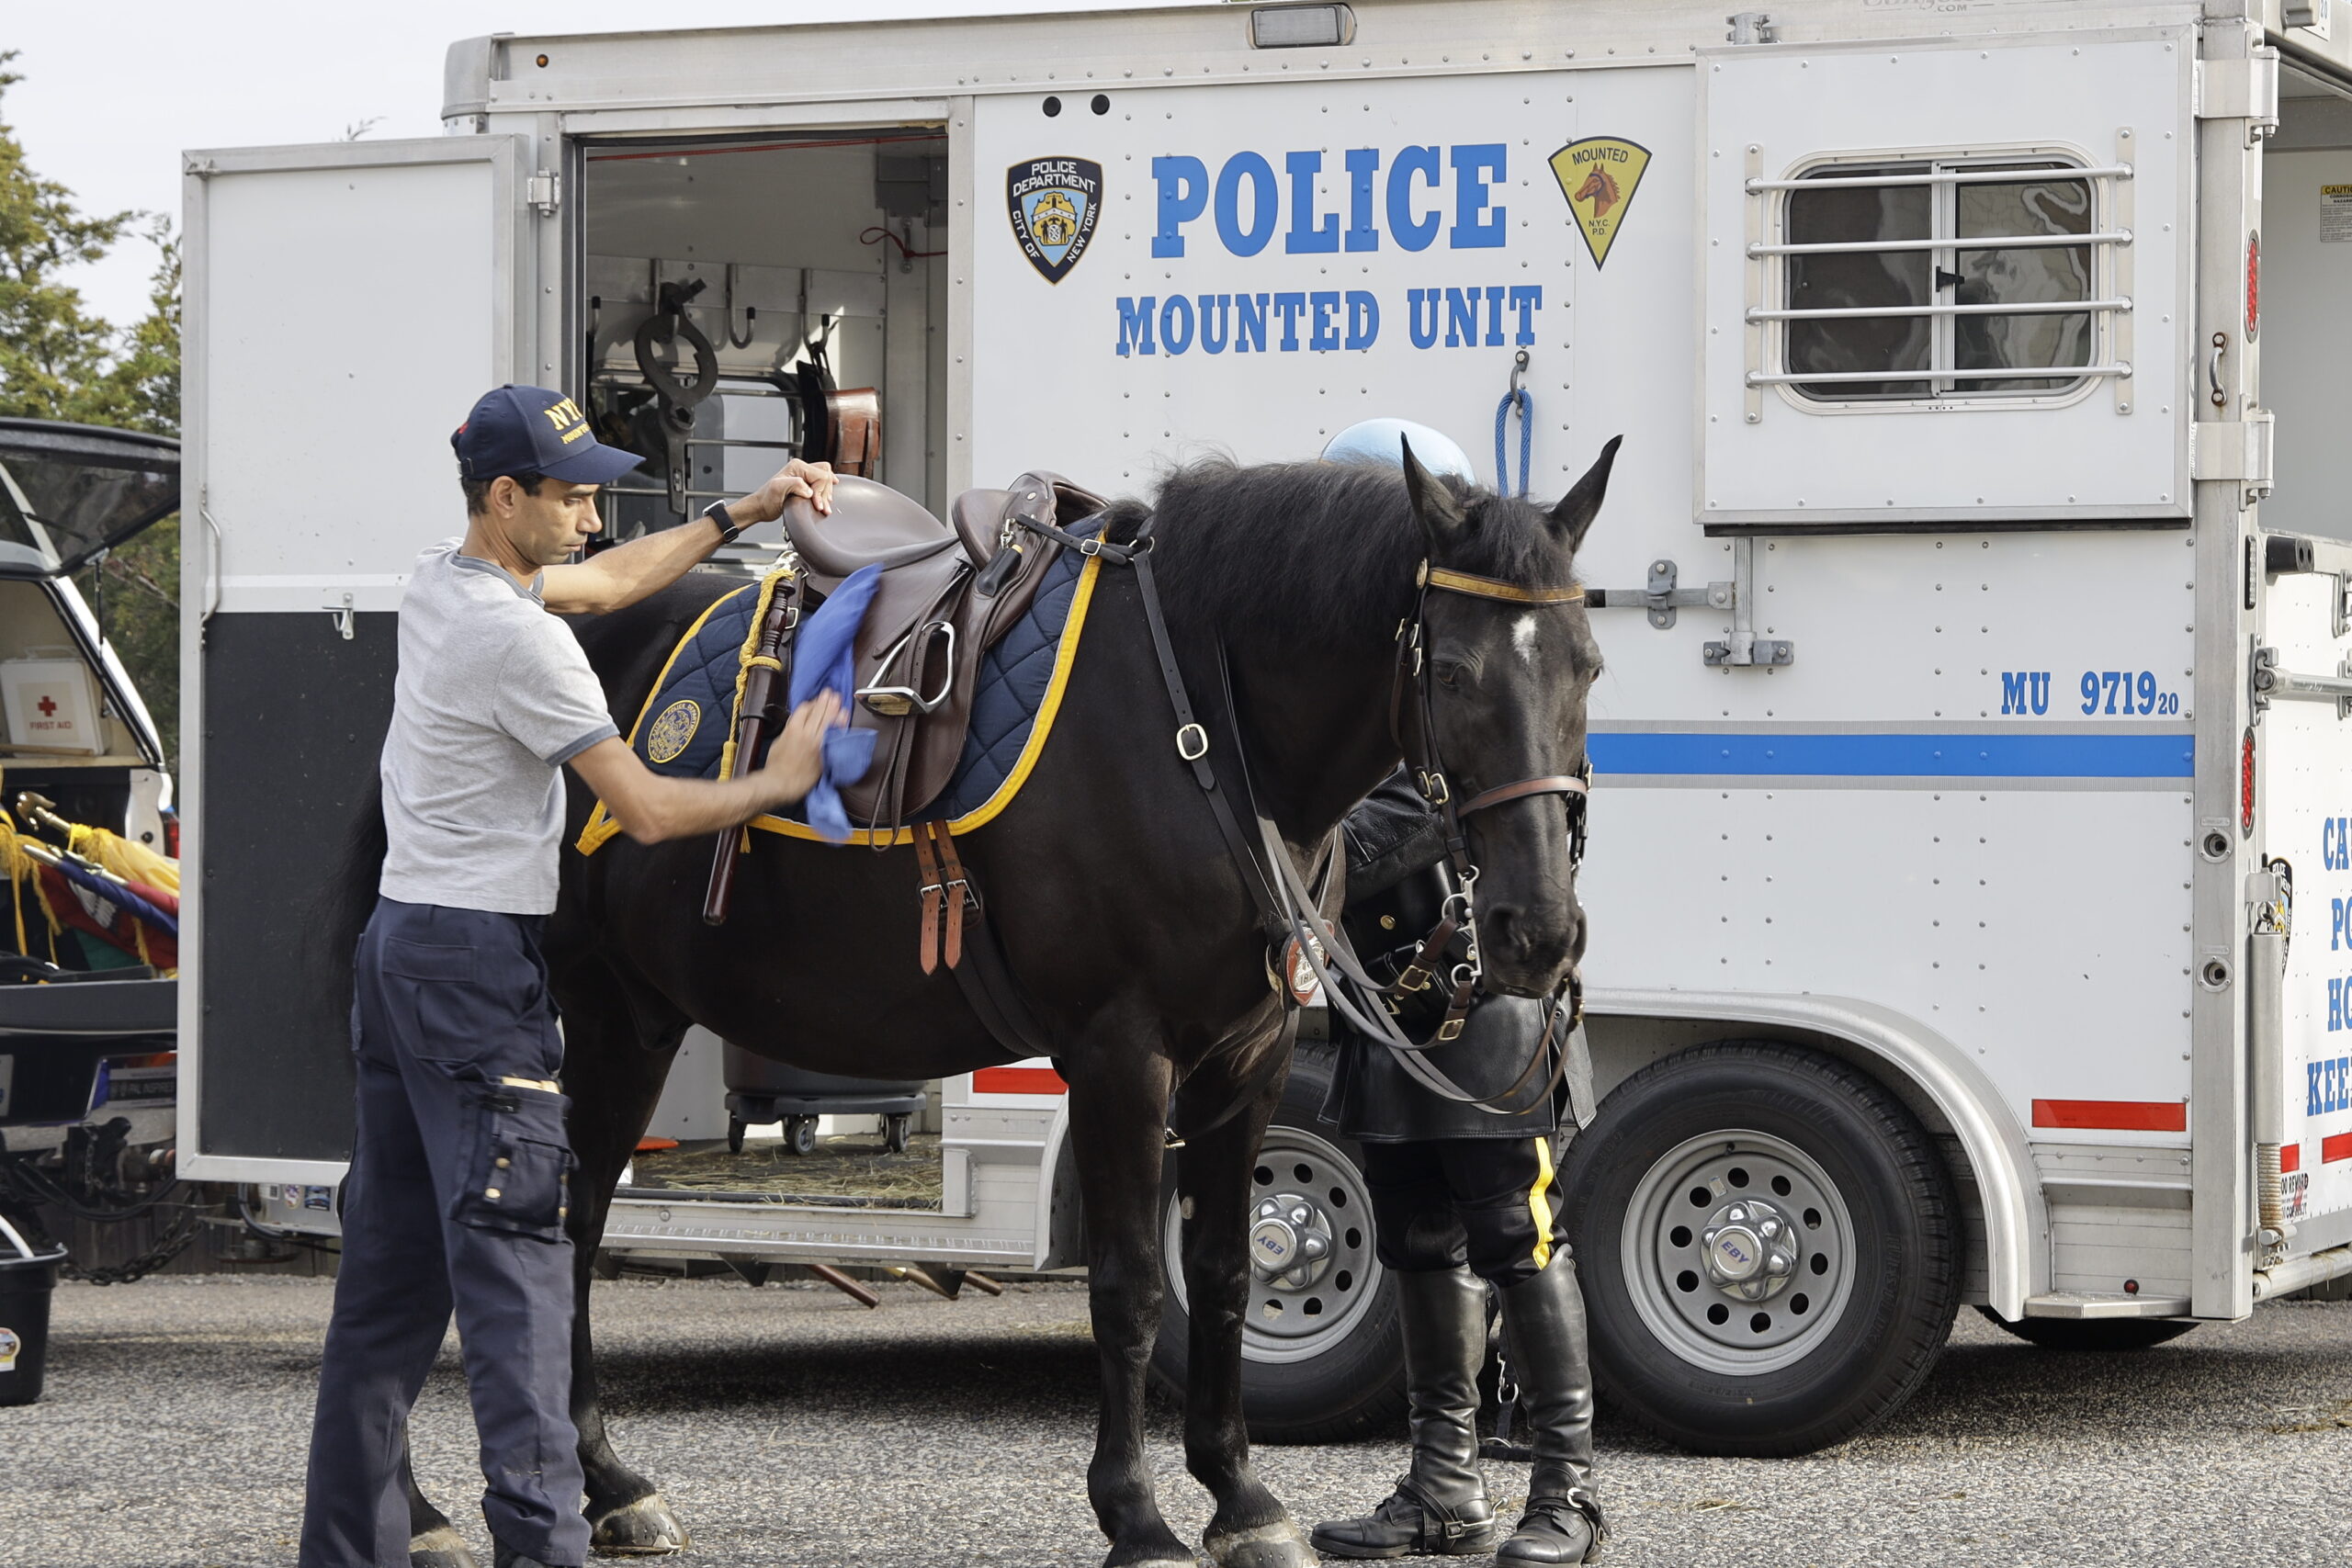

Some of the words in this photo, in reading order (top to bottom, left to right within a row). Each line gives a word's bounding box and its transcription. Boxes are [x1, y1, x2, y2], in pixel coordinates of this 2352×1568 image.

[1031, 161, 1077, 175] POLICE
[1572, 147, 1629, 165] MOUNTED
[1012, 174, 1096, 197] DEPARTMENT
[1151, 143, 1507, 258] POLICE
[1012, 210, 1030, 240] CITY
[1024, 243, 1040, 258] OF
[1066, 235, 1086, 264] NEW
[1081, 202, 1097, 234] YORK
[1116, 291, 1379, 355] MOUNTED
[1408, 285, 1542, 349] UNIT
[2001, 671, 2051, 716] MU
[2080, 671, 2156, 716] 9719
[2158, 693, 2179, 715] 20
[29, 721, 55, 730] FIRST
[57, 720, 73, 729] AID
[2323, 818, 2352, 871] CA
[2307, 1055, 2352, 1116] KEE
[1256, 1235, 1284, 1256] EBY
[1720, 1241, 1750, 1263] EBY
